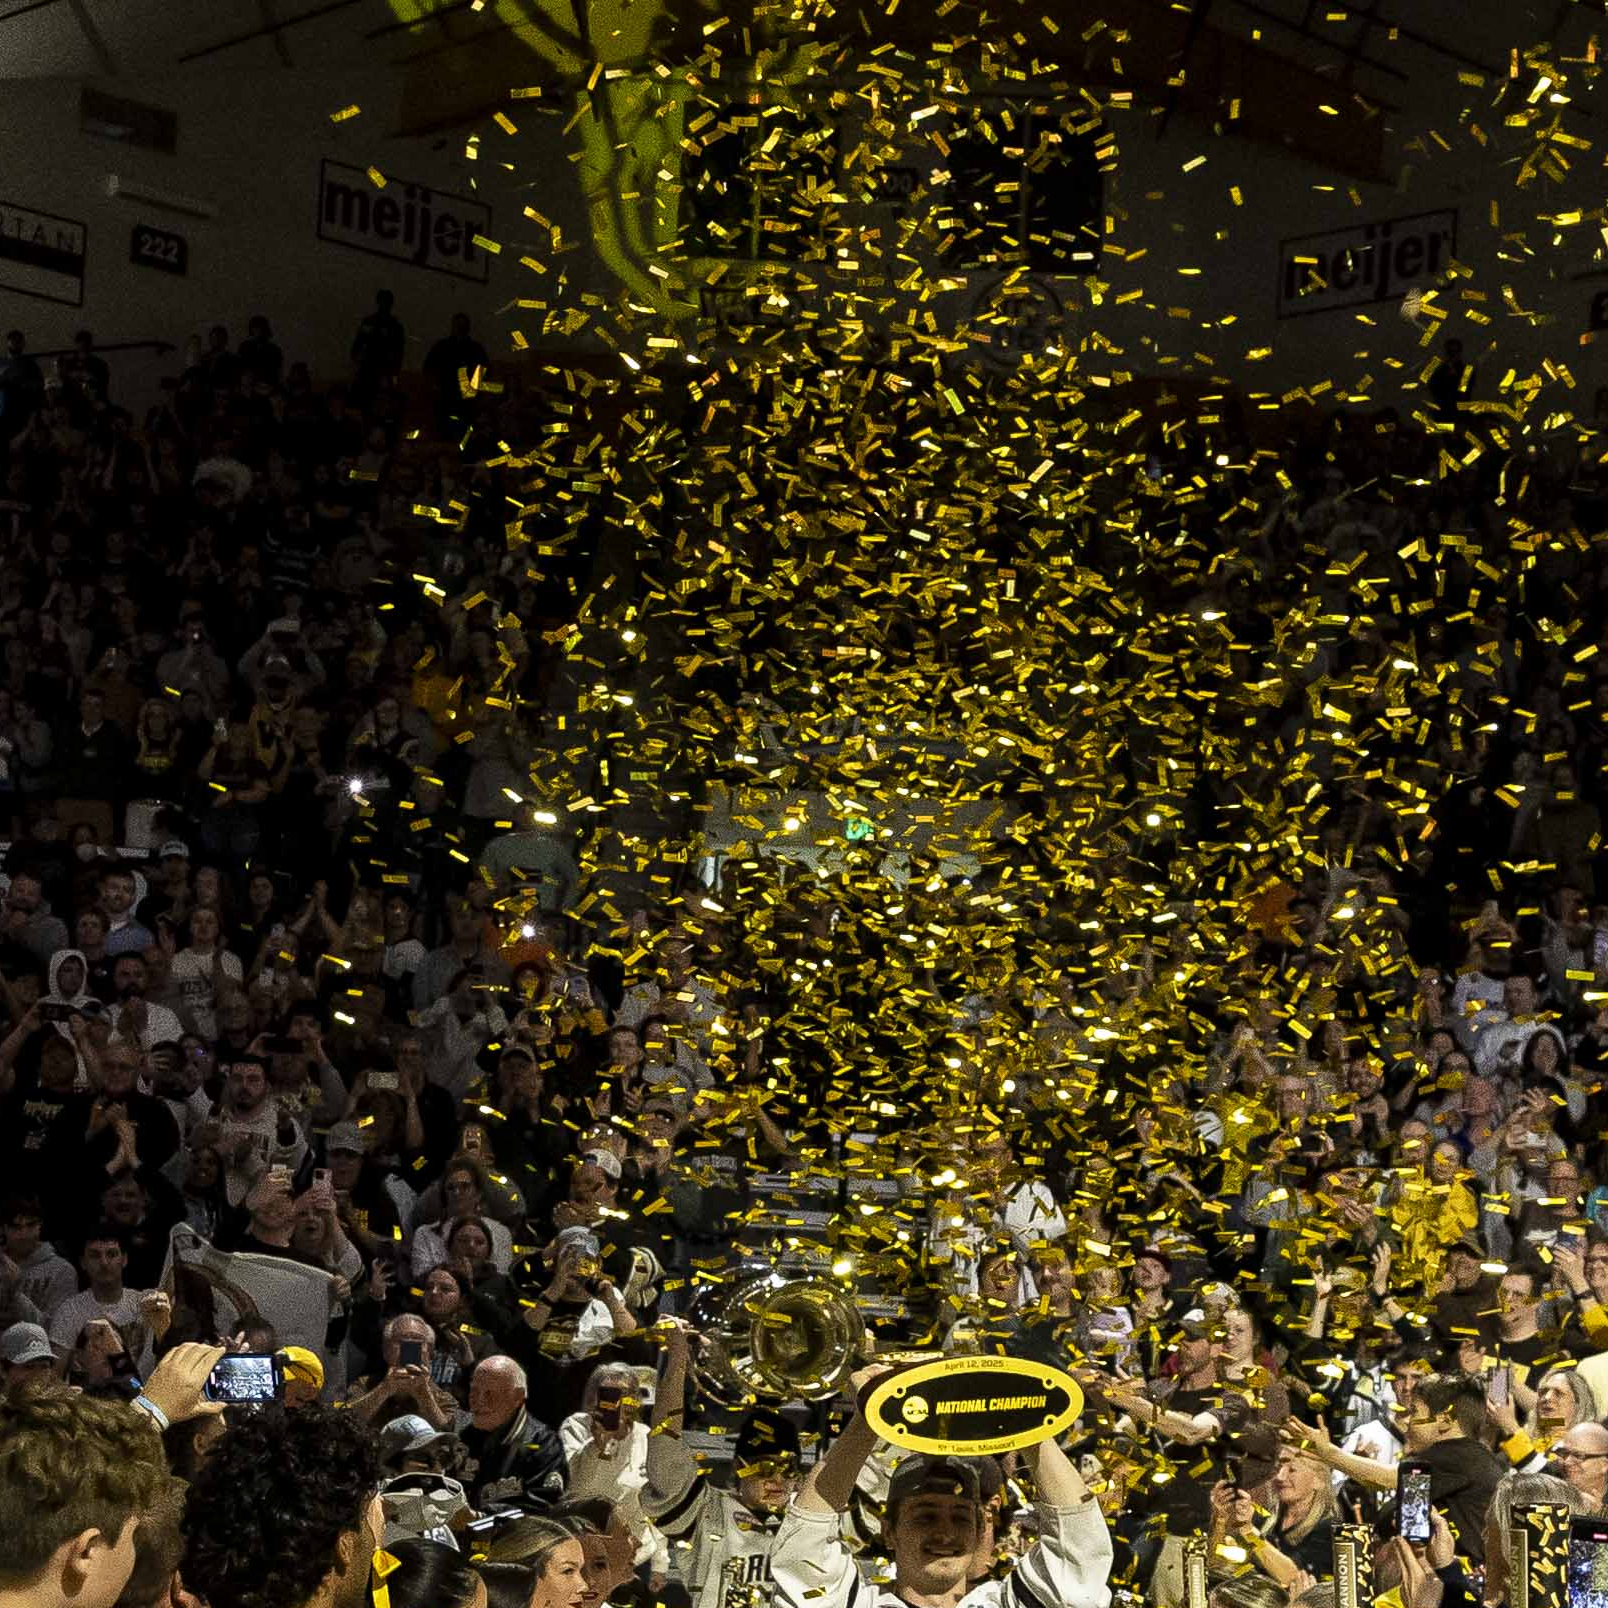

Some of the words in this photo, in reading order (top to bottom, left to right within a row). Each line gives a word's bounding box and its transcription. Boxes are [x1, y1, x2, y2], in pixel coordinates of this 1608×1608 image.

[326, 183, 480, 266] meijer
[139, 234, 178, 264] 222
[1286, 222, 1447, 300] meijer
[981, 1360, 1005, 1368] 2025
[936, 1400, 987, 1415] NATIONAL
[989, 1396, 1047, 1411] CHAMPION
[978, 1440, 1016, 1452] Missouri
